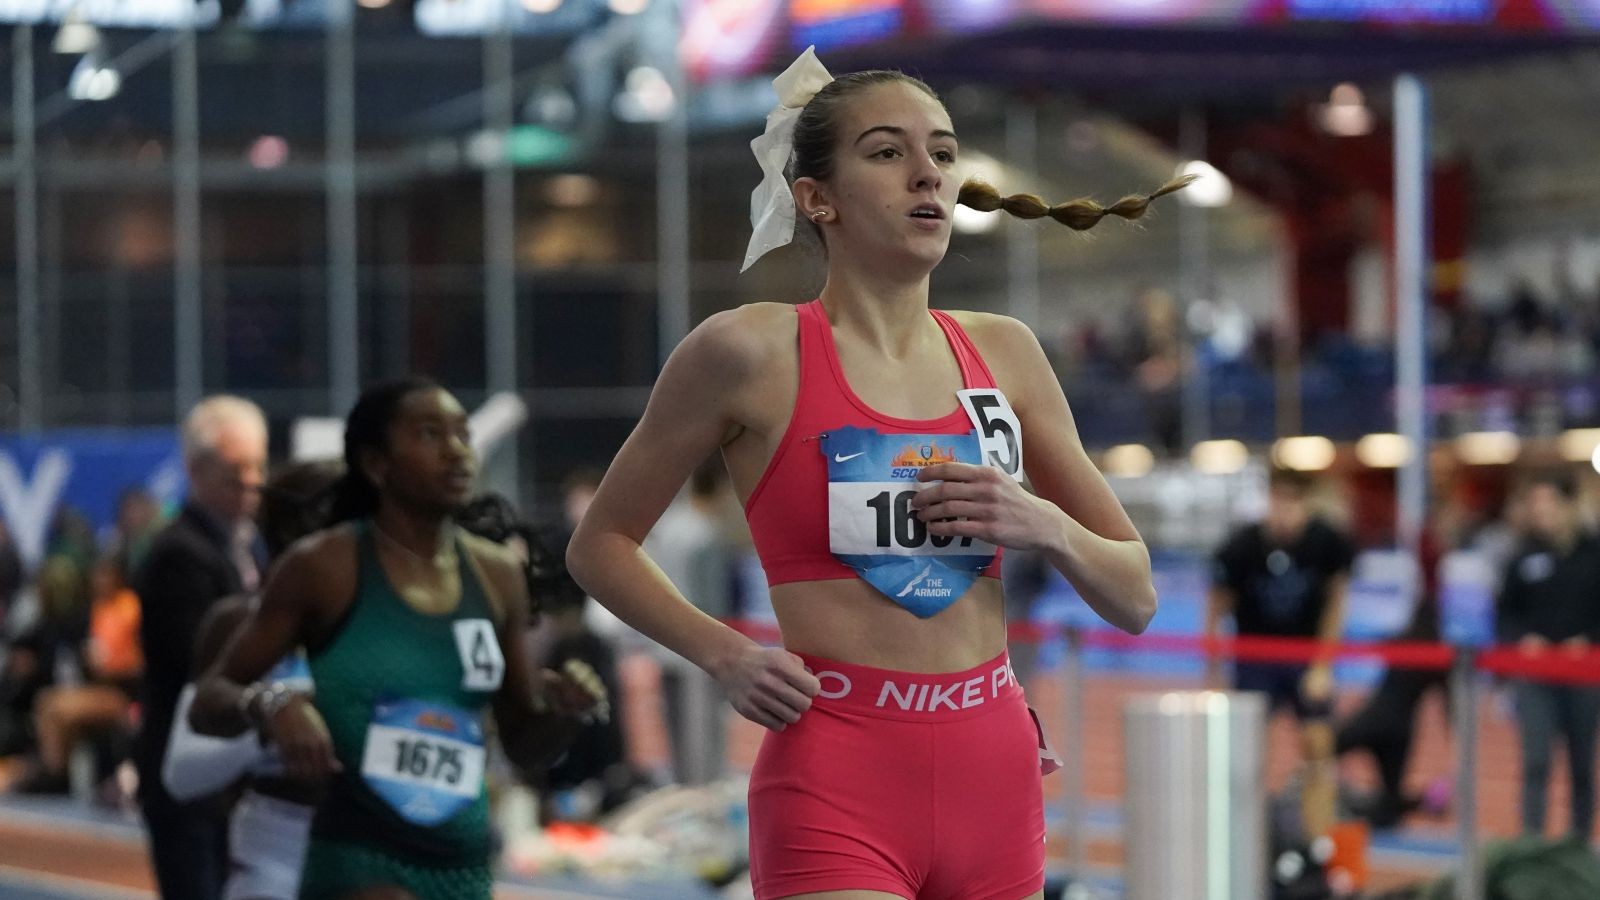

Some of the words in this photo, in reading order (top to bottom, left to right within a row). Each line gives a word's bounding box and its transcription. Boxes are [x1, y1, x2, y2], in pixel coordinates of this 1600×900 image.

[969, 394, 1019, 475] 5
[914, 588, 952, 597] ARMORY
[926, 578, 943, 588] THE
[472, 629, 493, 681] 4
[875, 675, 985, 712] NIKE
[394, 739, 463, 785] 1675
